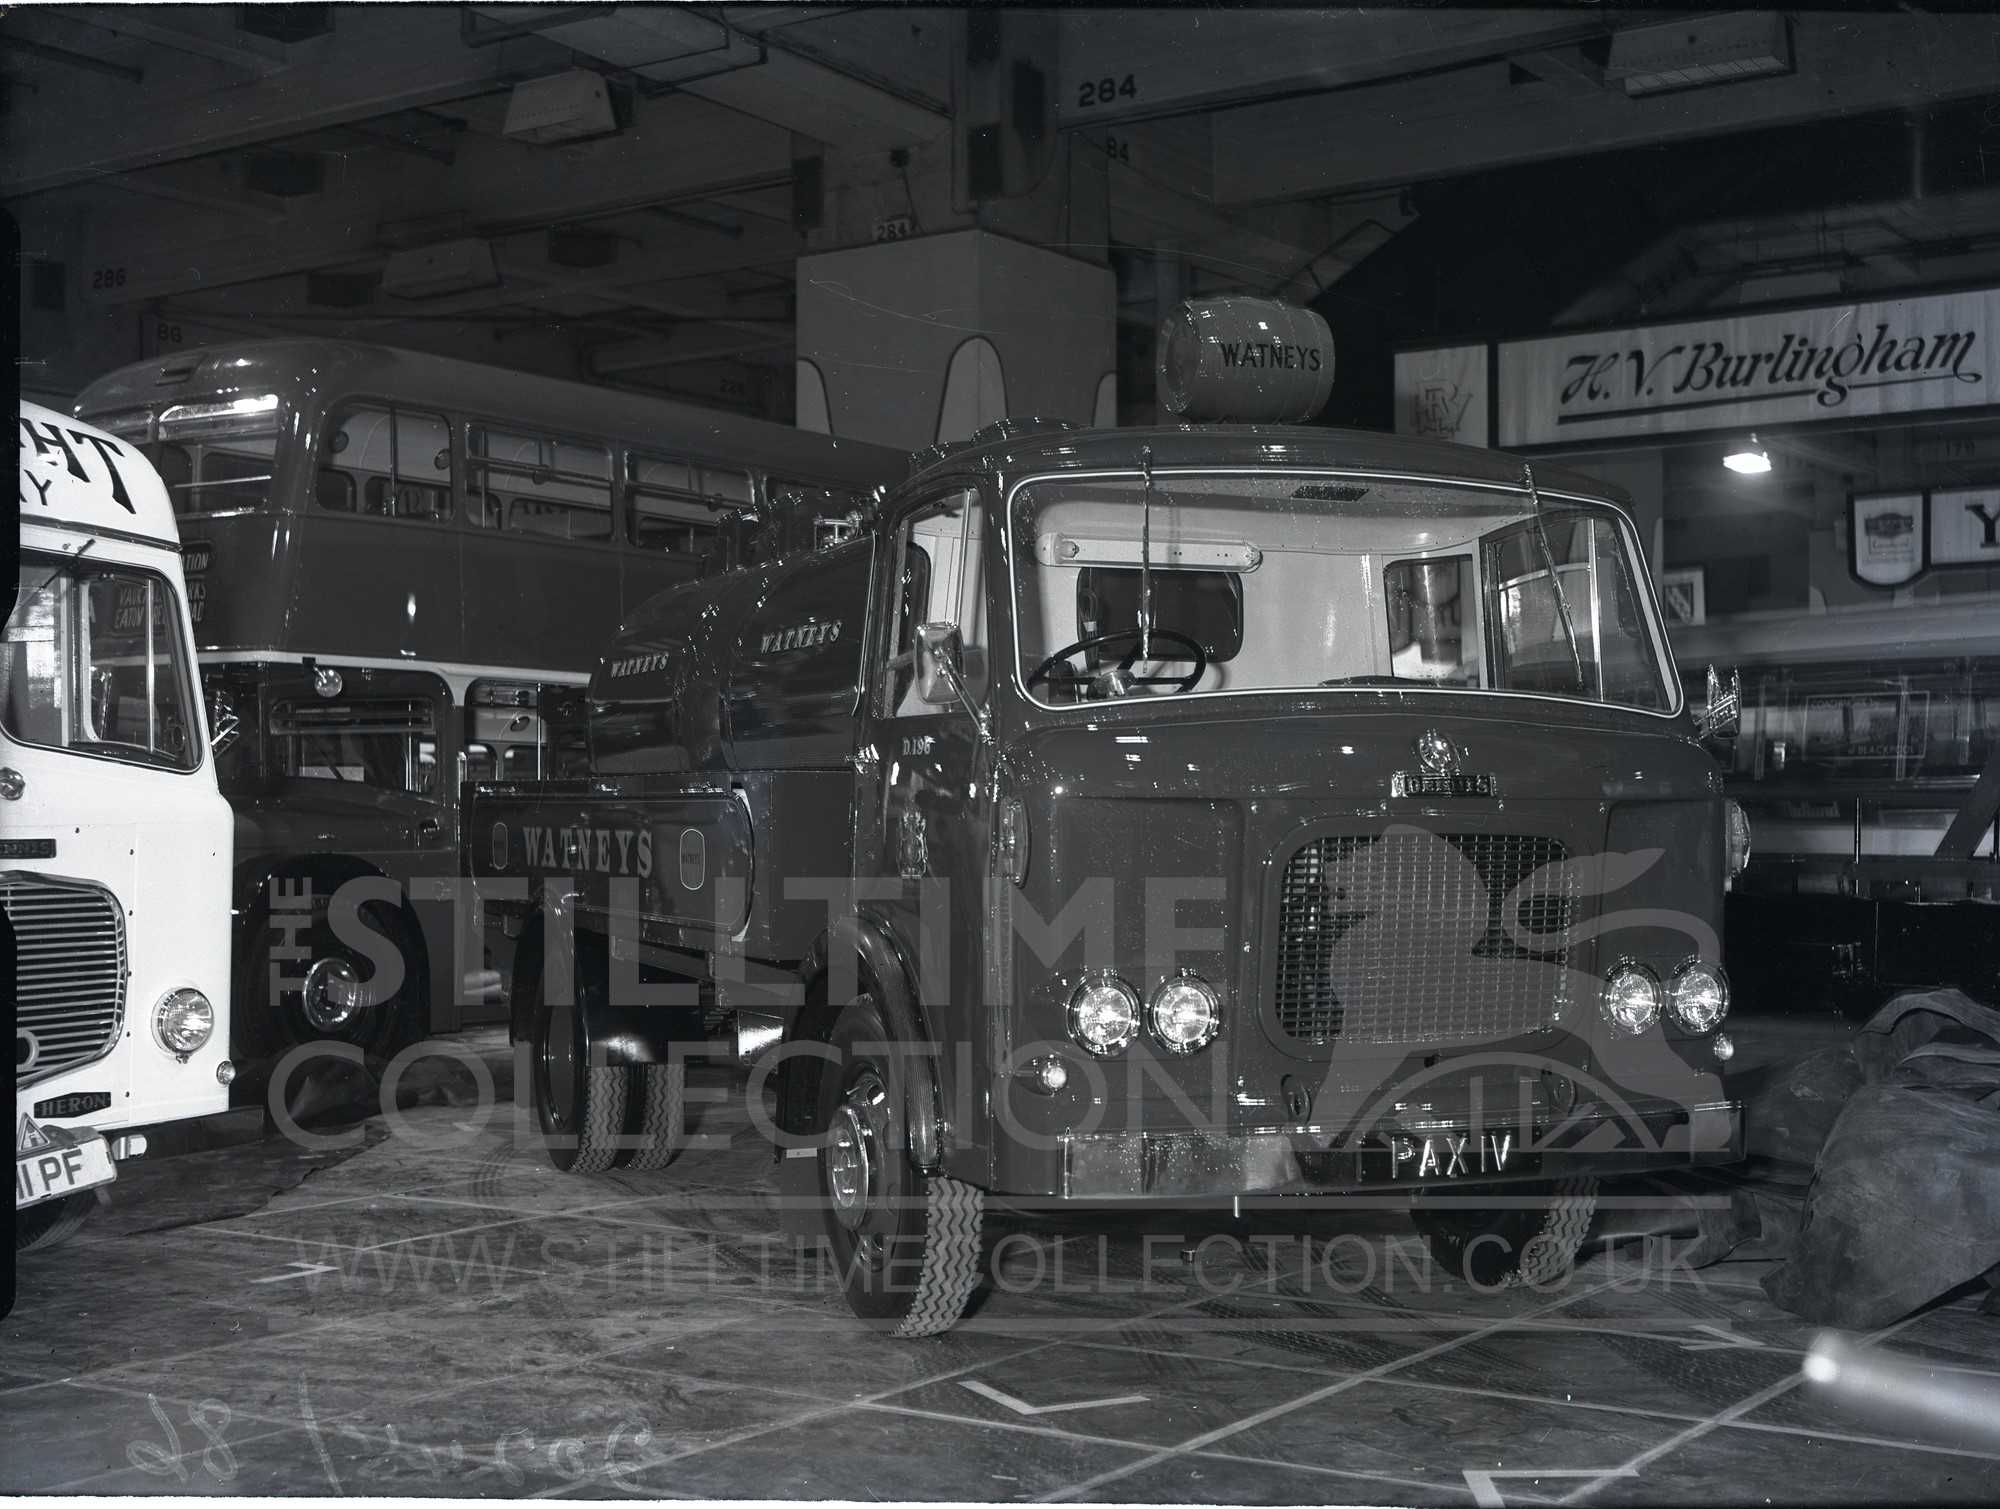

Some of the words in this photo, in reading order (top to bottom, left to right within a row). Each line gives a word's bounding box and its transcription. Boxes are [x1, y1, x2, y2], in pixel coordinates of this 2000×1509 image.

[1079, 74, 1136, 107] 284
[1220, 343, 1321, 372] WATNEYS
[1673, 324, 1983, 407] Burlingham
[20, 417, 137, 515] HT
[20, 469, 52, 507] Y
[182, 551, 209, 572] TION
[761, 620, 843, 654] WATNEYS
[611, 651, 670, 678] WATNEYS
[521, 825, 653, 879] WATNEYS
[41, 1093, 107, 1117] HERON
